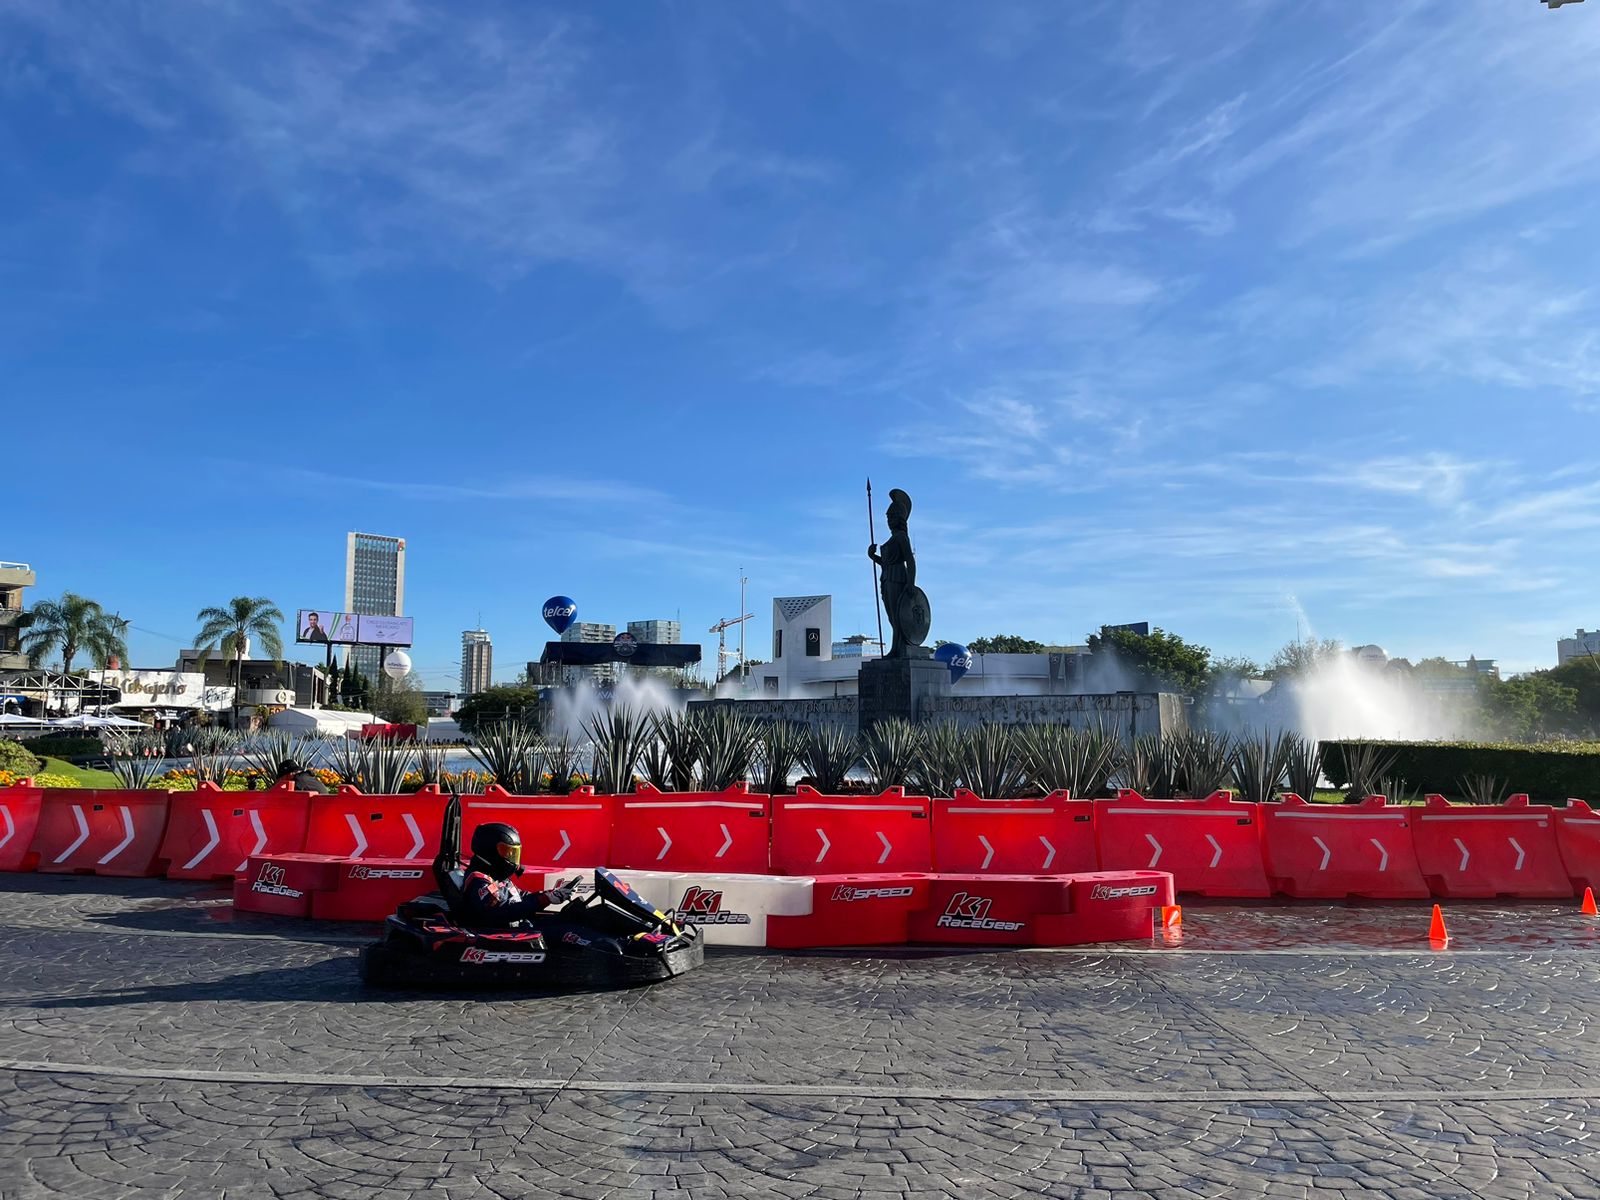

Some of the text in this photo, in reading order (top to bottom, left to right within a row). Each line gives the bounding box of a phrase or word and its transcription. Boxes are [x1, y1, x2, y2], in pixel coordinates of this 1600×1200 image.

[544, 604, 576, 618] telcel
[257, 862, 286, 887] K1
[679, 886, 724, 915] K1
[944, 892, 992, 919] K1
